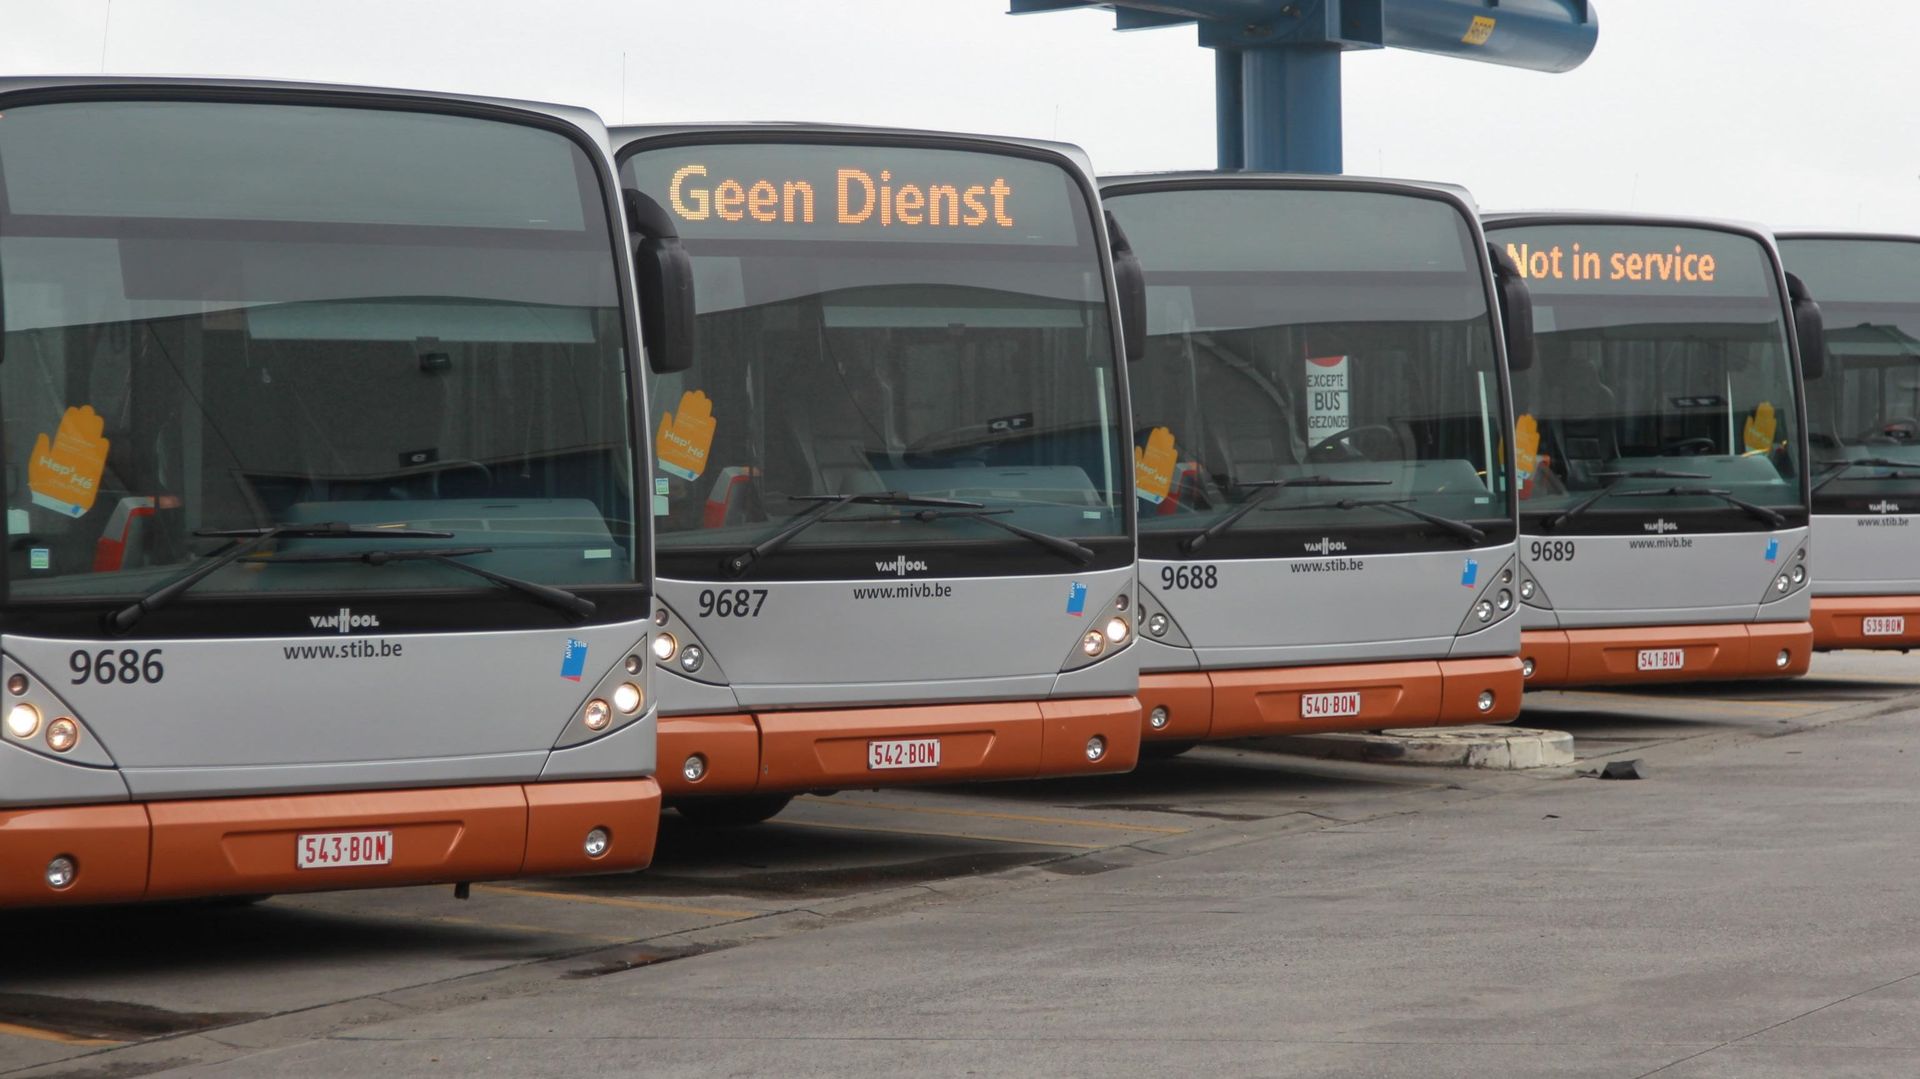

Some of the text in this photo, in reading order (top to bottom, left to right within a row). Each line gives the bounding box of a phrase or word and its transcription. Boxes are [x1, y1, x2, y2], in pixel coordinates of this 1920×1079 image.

[669, 164, 1013, 227] Geen Dienst
[1506, 242, 1716, 282] Not in service
[1314, 391, 1341, 411] BUS
[1857, 516, 1909, 527] www.stib.be
[1530, 540, 1575, 562] 9689
[1629, 537, 1693, 549] www.mivb.be
[1290, 558, 1364, 573] www.stib.be
[1161, 564, 1218, 591] 9688
[853, 582, 952, 600] www.mivb.be
[698, 588, 769, 618] 9687
[283, 639, 403, 660] www.stib.be
[69, 648, 164, 685] 9686
